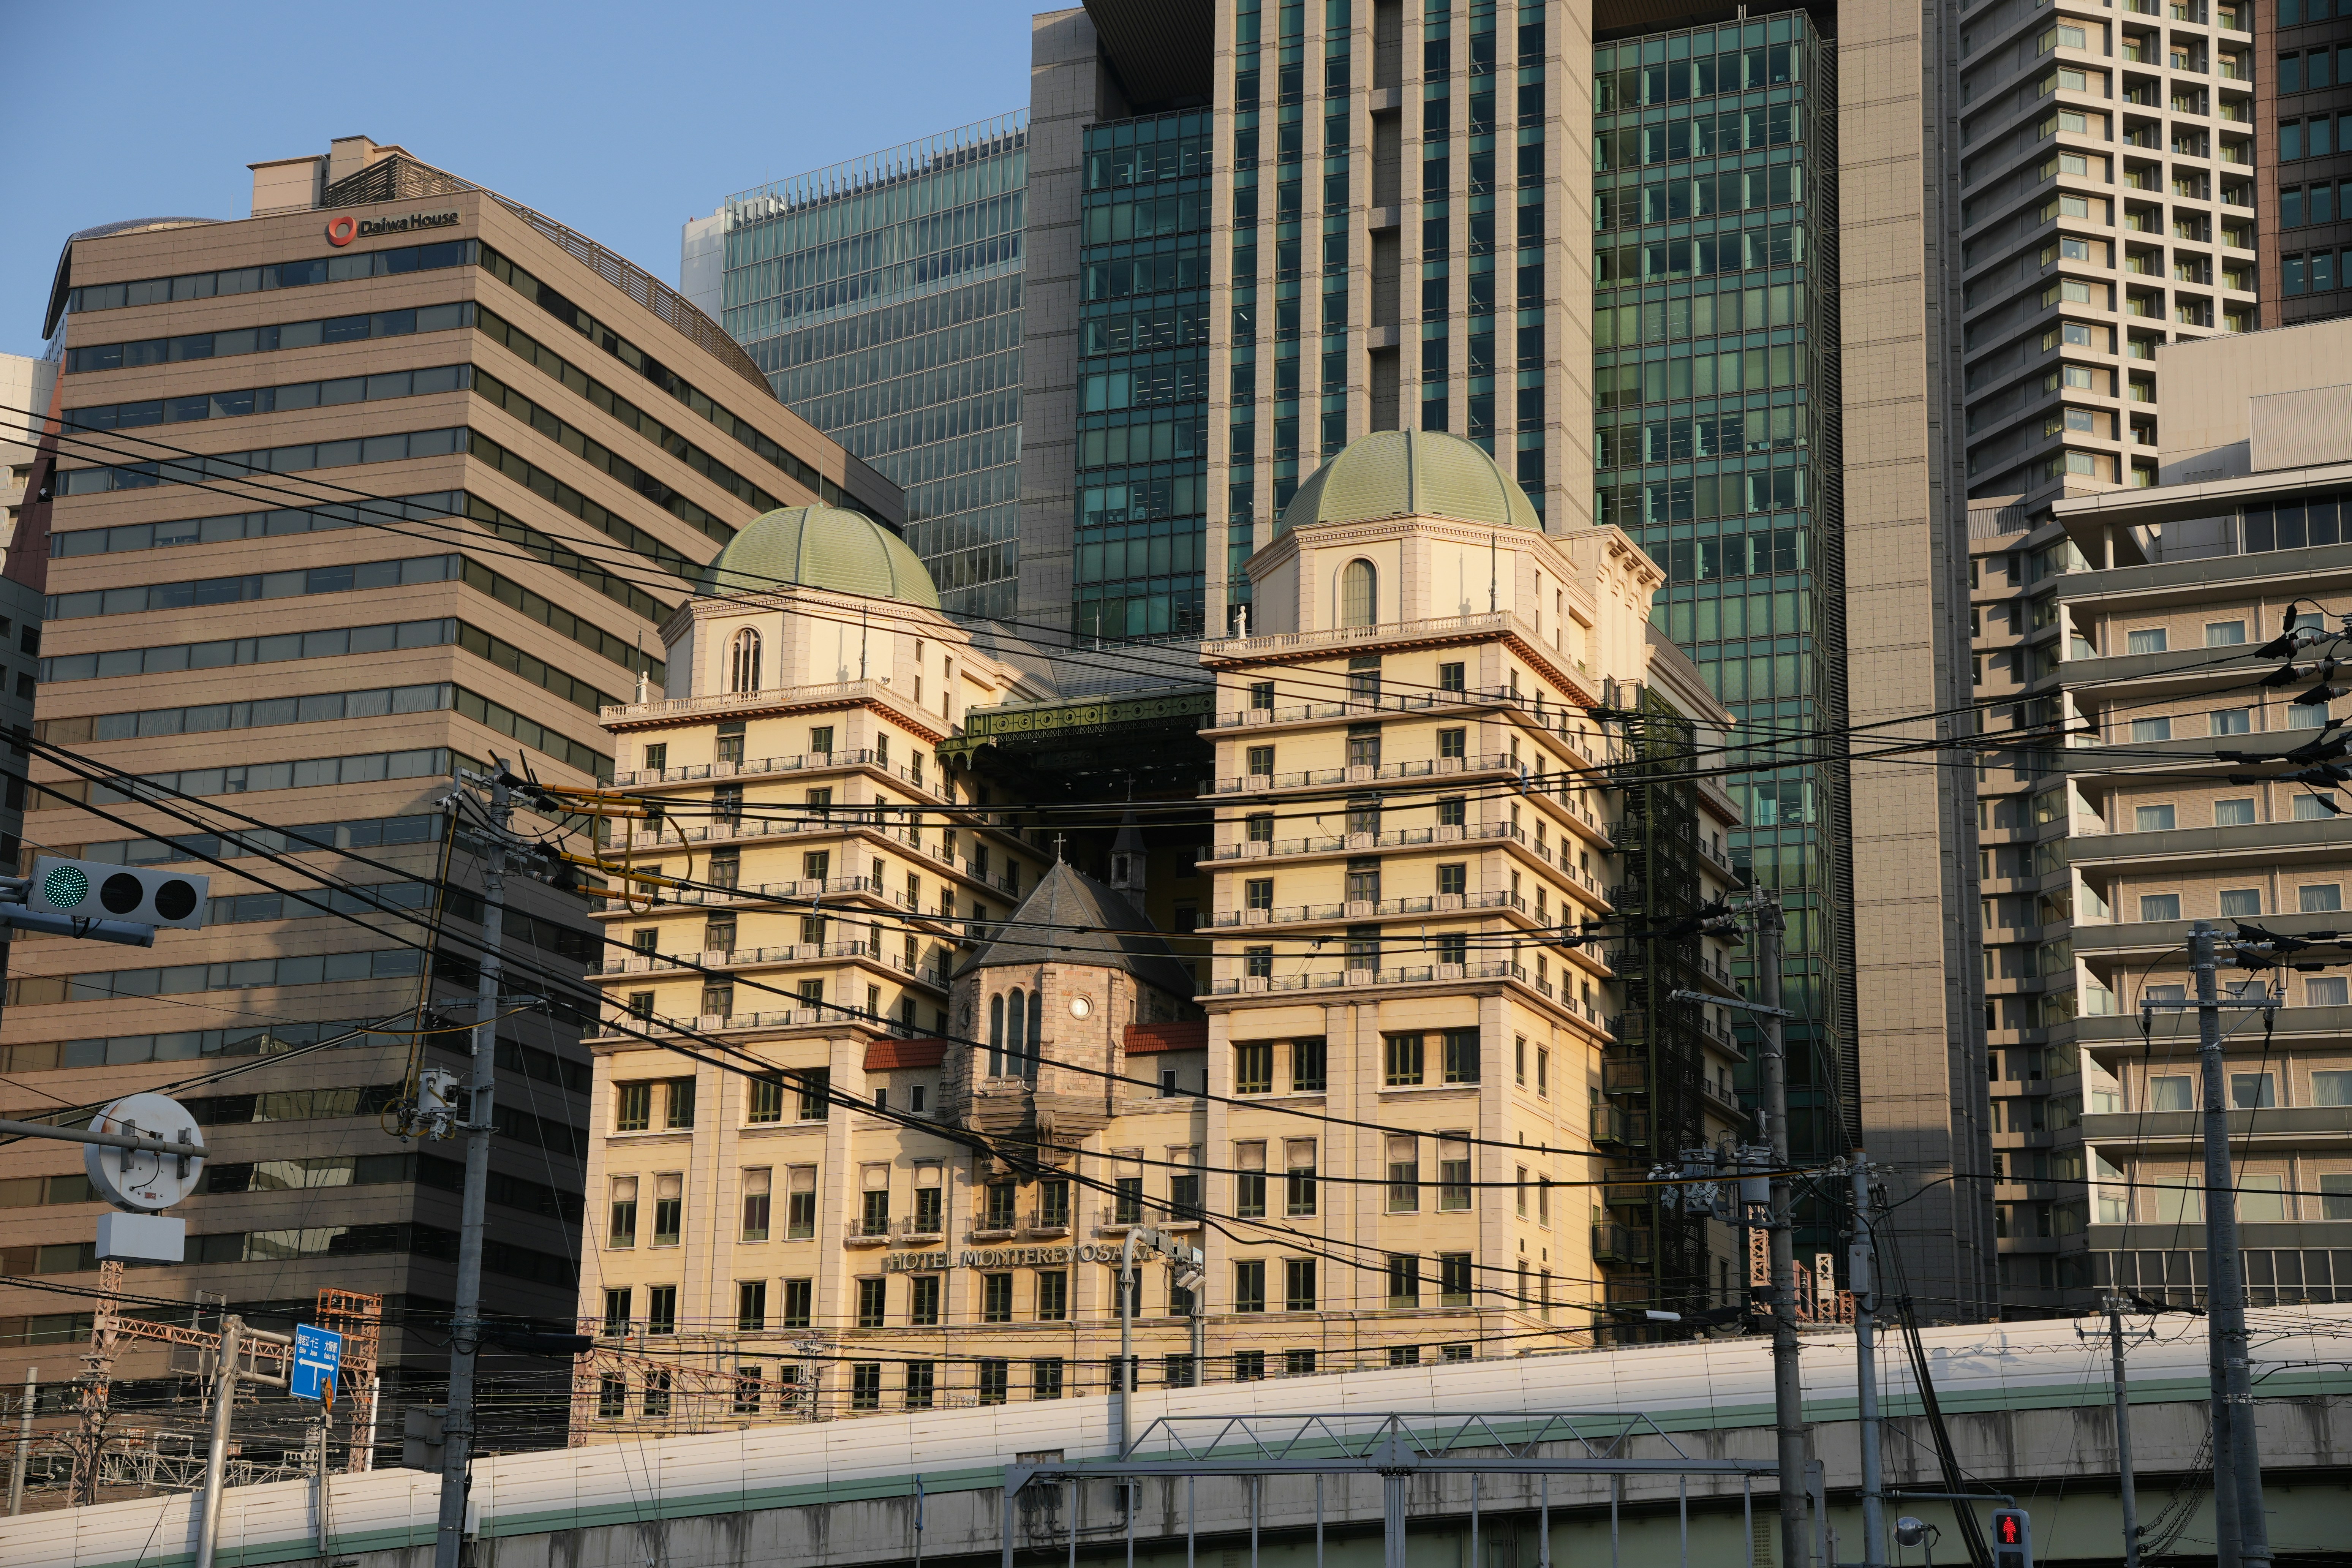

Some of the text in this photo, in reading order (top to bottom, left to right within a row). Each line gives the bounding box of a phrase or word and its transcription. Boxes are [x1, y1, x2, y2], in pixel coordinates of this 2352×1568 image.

[360, 212, 458, 234] Daiwa House
[890, 1251, 957, 1270] HOTEL
[962, 1246, 1078, 1267] MONTEREY
[324, 1340, 338, 1353] 大阪駅
